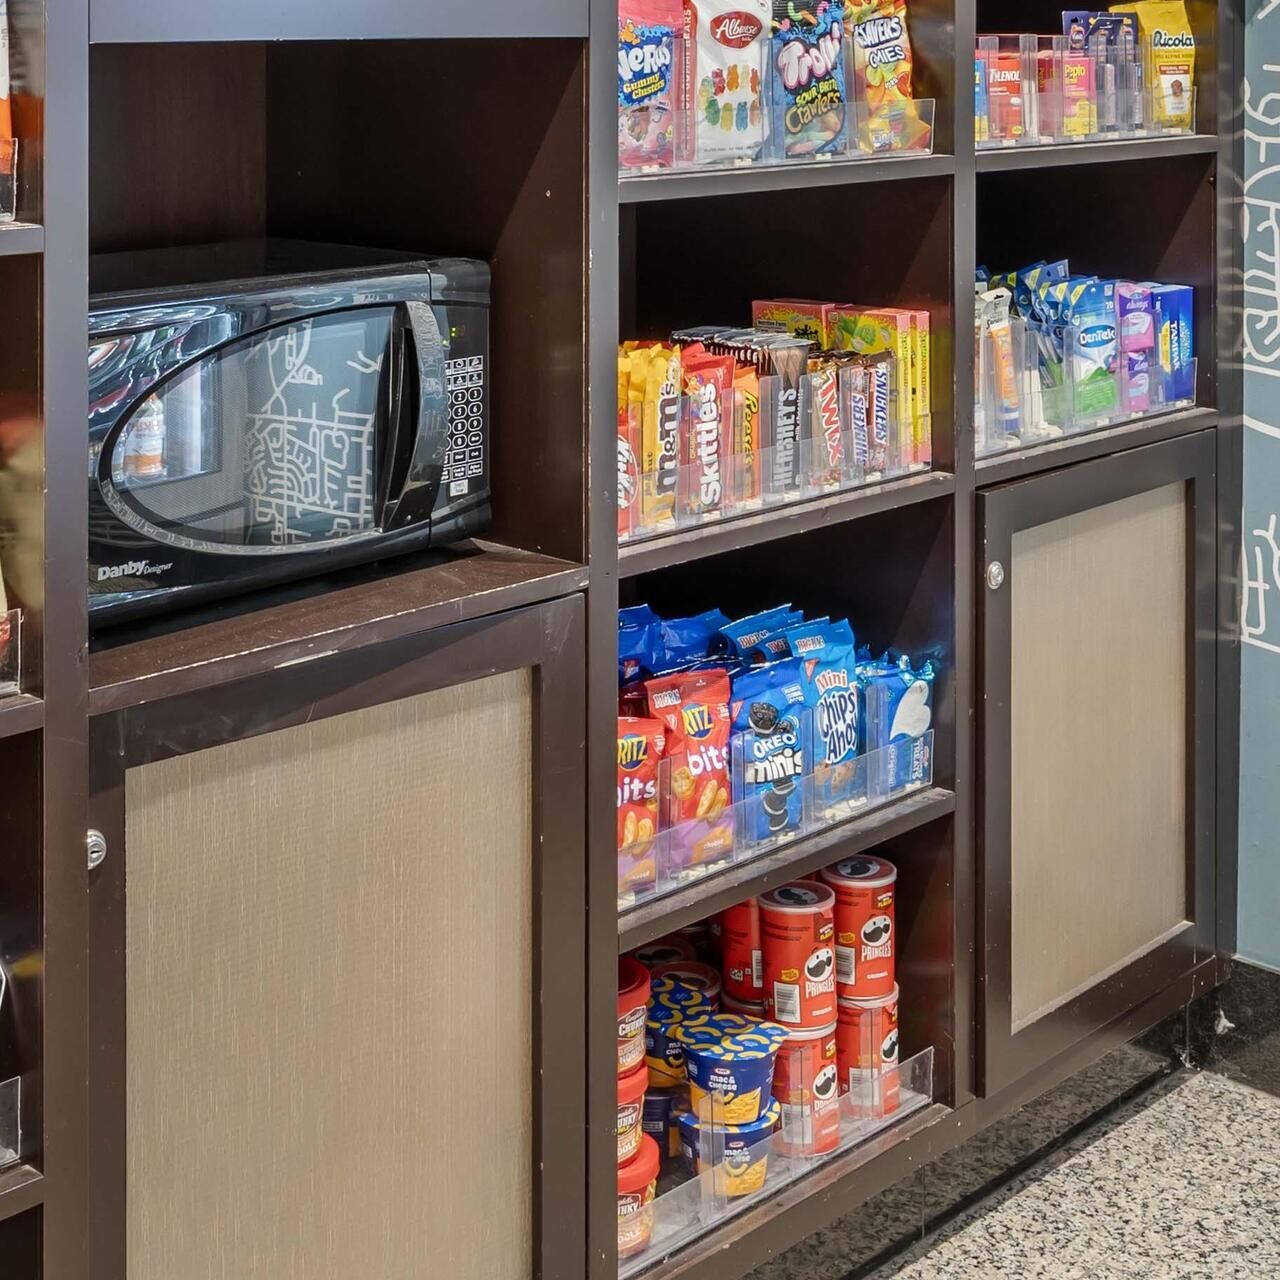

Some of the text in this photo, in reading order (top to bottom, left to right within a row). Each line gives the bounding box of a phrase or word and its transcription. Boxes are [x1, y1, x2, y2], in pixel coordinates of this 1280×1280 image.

[1153, 30, 1194, 48] Ricola
[624, 73, 660, 92] Gummy
[1064, 64, 1086, 77] Pepto
[632, 80, 664, 99] Clusters
[796, 85, 817, 105] SOUR
[786, 92, 840, 134] Crawlers
[1080, 329, 1115, 344] DenTek
[819, 369, 842, 466] TWIX
[875, 371, 887, 444] SNICKERS
[696, 383, 719, 505] Skittles
[98, 561, 173, 580] Danby Designer
[817, 670, 848, 689] Mini
[683, 705, 713, 736] RITZ
[820, 691, 855, 738] Chips
[618, 737, 647, 763] RITZ
[753, 733, 796, 758] OREO
[755, 750, 802, 783] minis
[862, 942, 891, 962] PRINGLES
[806, 976, 835, 1000] PRINGLES
